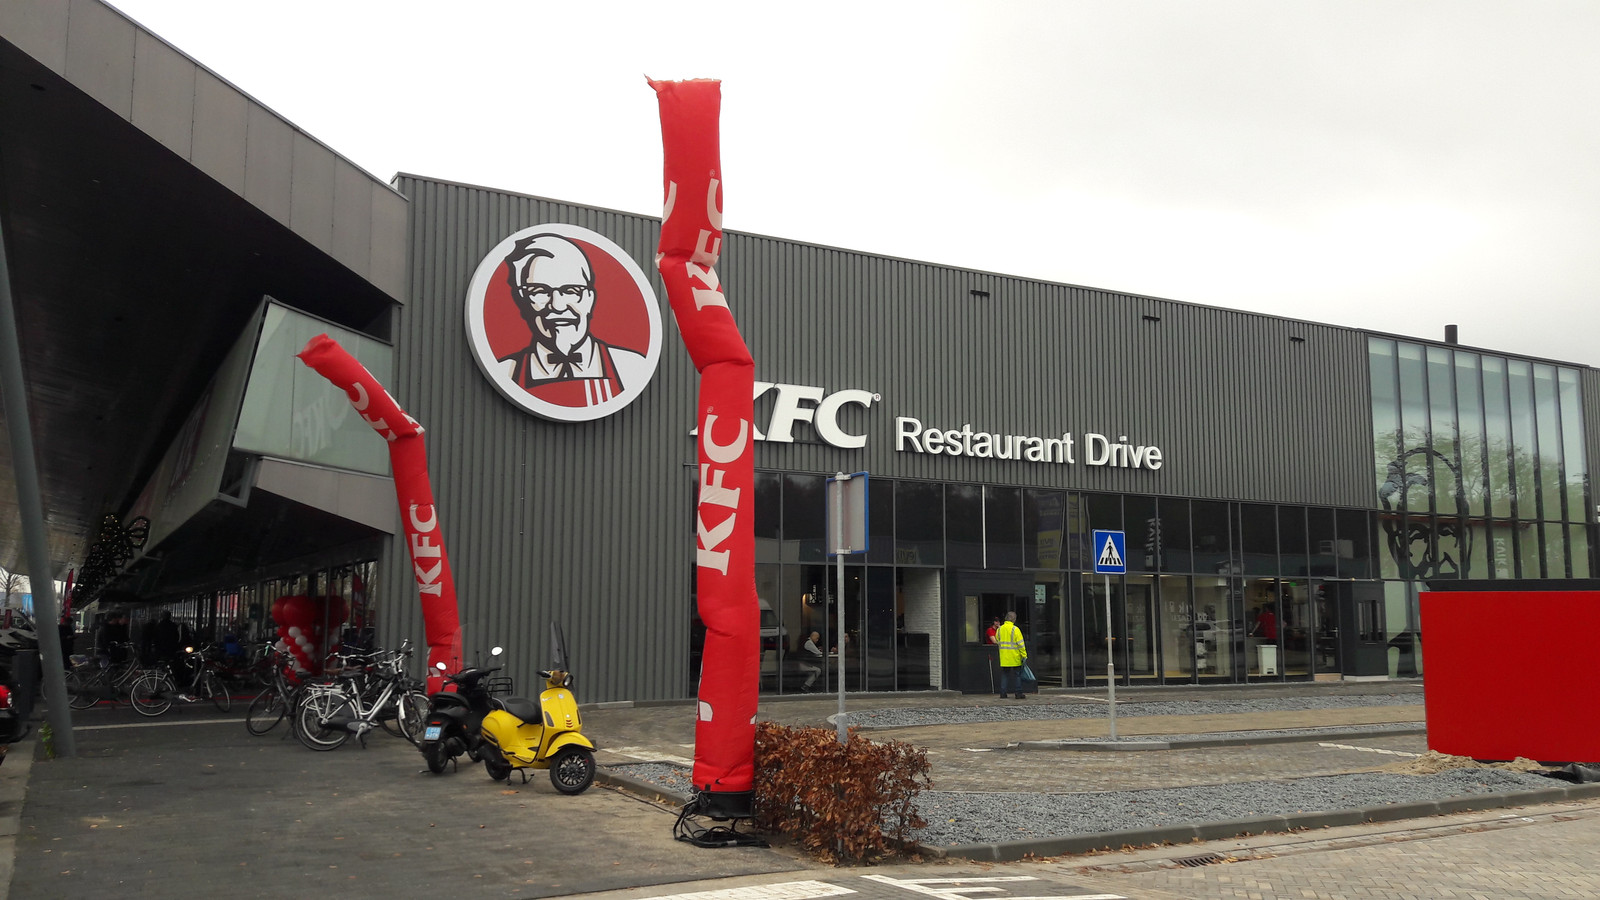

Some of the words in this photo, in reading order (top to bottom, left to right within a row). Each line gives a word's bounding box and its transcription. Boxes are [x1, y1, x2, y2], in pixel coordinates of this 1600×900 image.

[895, 416, 1075, 465] Restaurant
[1084, 432, 1163, 470] Drive
[697, 413, 748, 576] KFC
[409, 504, 443, 598] KFC
